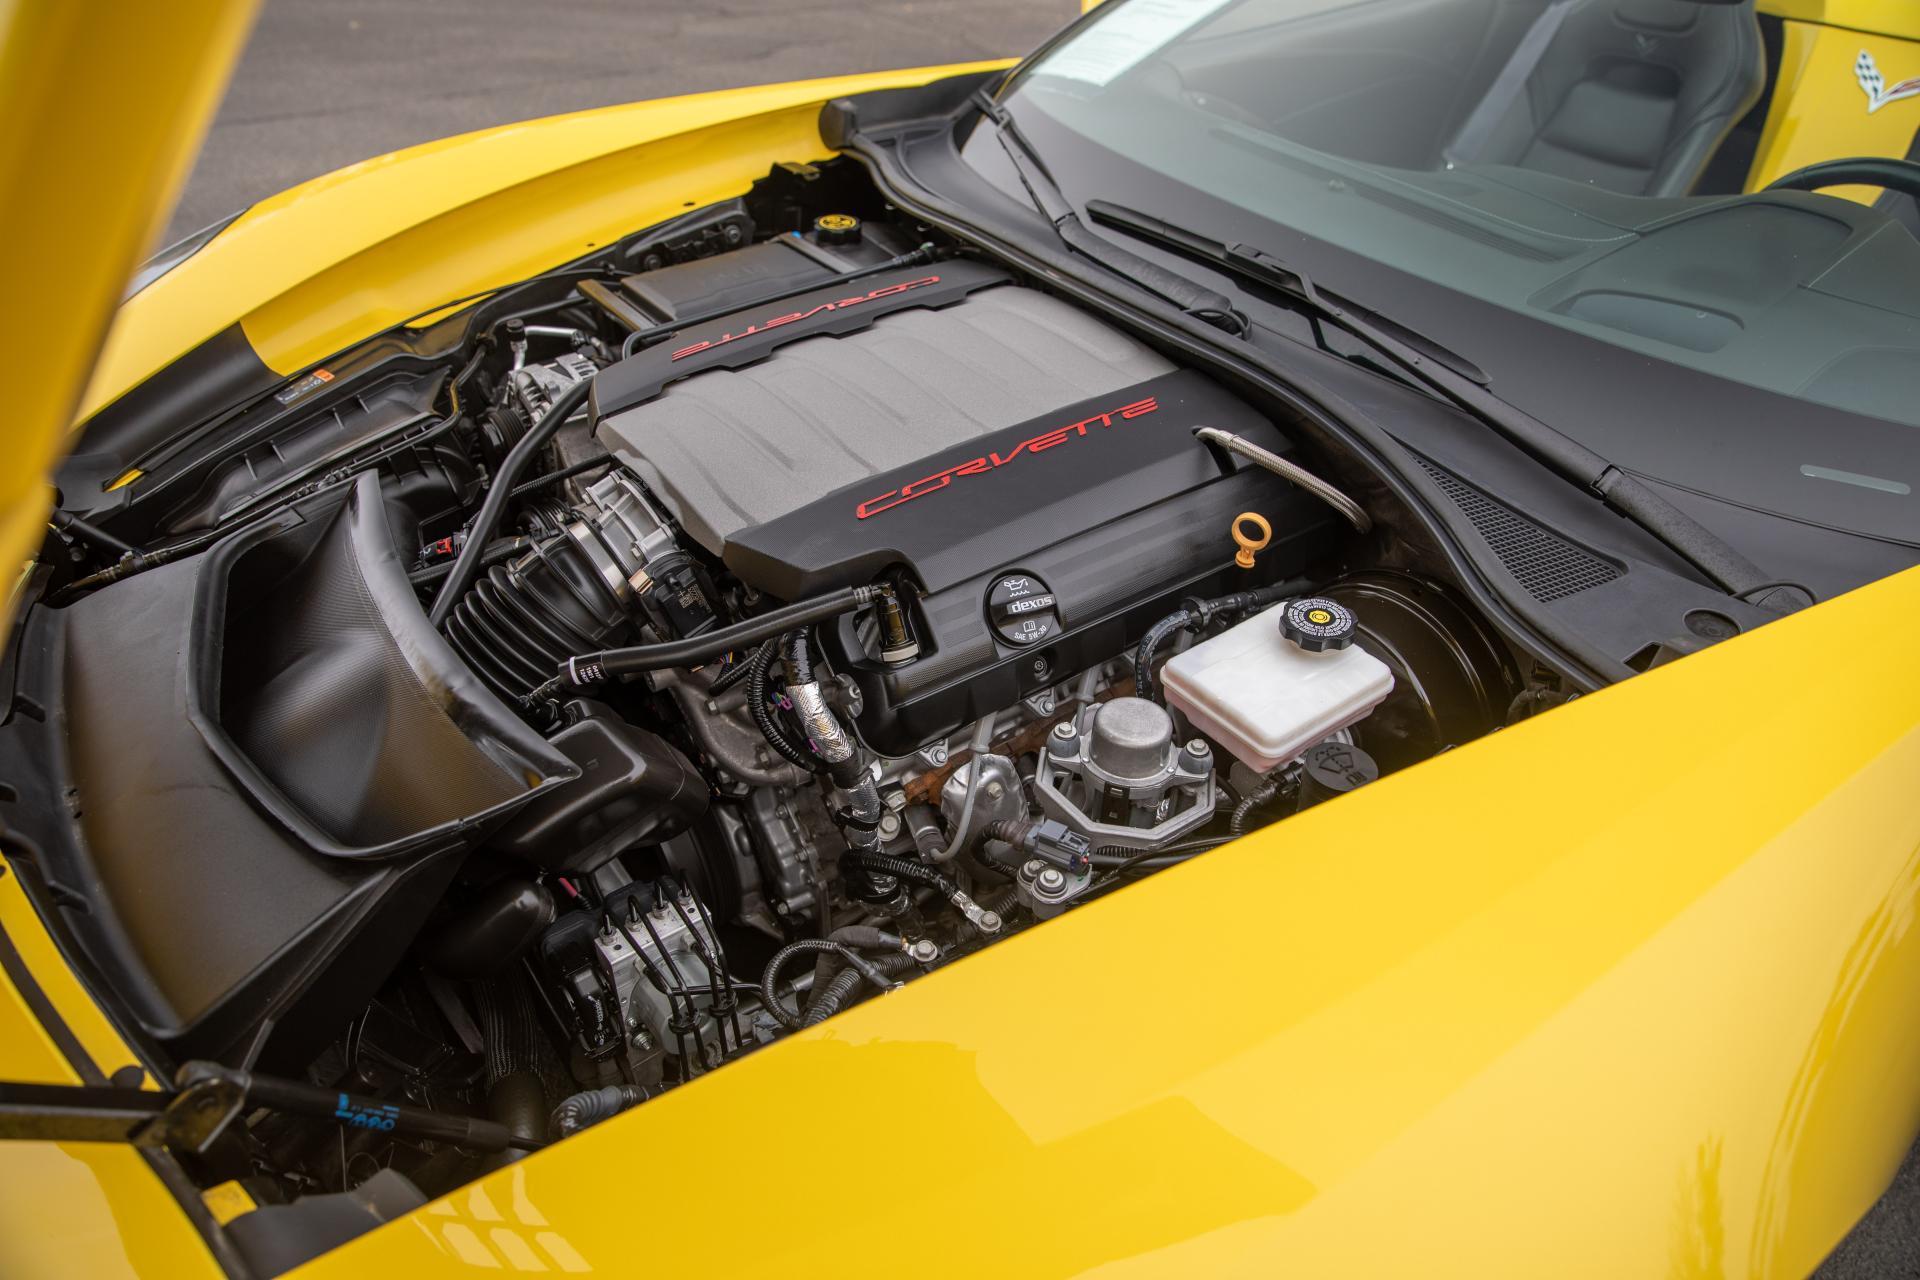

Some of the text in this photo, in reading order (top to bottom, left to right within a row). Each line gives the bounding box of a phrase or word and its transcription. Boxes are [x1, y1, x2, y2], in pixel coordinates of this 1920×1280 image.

[672, 275, 940, 361] CORVETTE
[856, 396, 1159, 519] CORVETTE
[1011, 596, 1053, 613] dexos
[1014, 625, 1047, 641] SAE 5W-30
